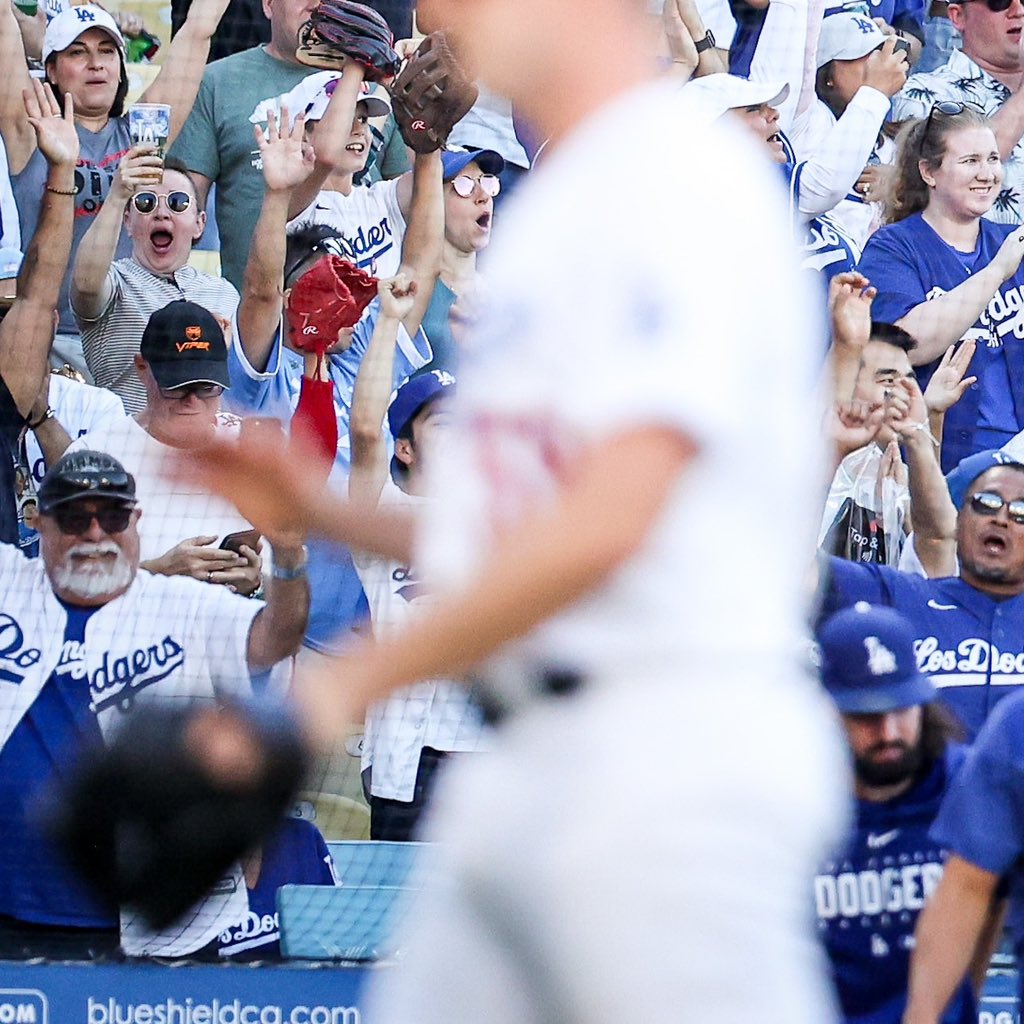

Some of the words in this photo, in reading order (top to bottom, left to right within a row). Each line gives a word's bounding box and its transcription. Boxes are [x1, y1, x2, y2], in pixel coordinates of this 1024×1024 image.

[75, 7, 95, 22] LA
[855, 17, 876, 34] LA
[175, 341, 210, 353] VIPER
[851, 528, 868, 547] Tap
[870, 537, 879, 550] &
[913, 637, 956, 673] Los
[815, 863, 945, 919] DODGER
[88, 996, 361, 1024] blueshieldca.com
